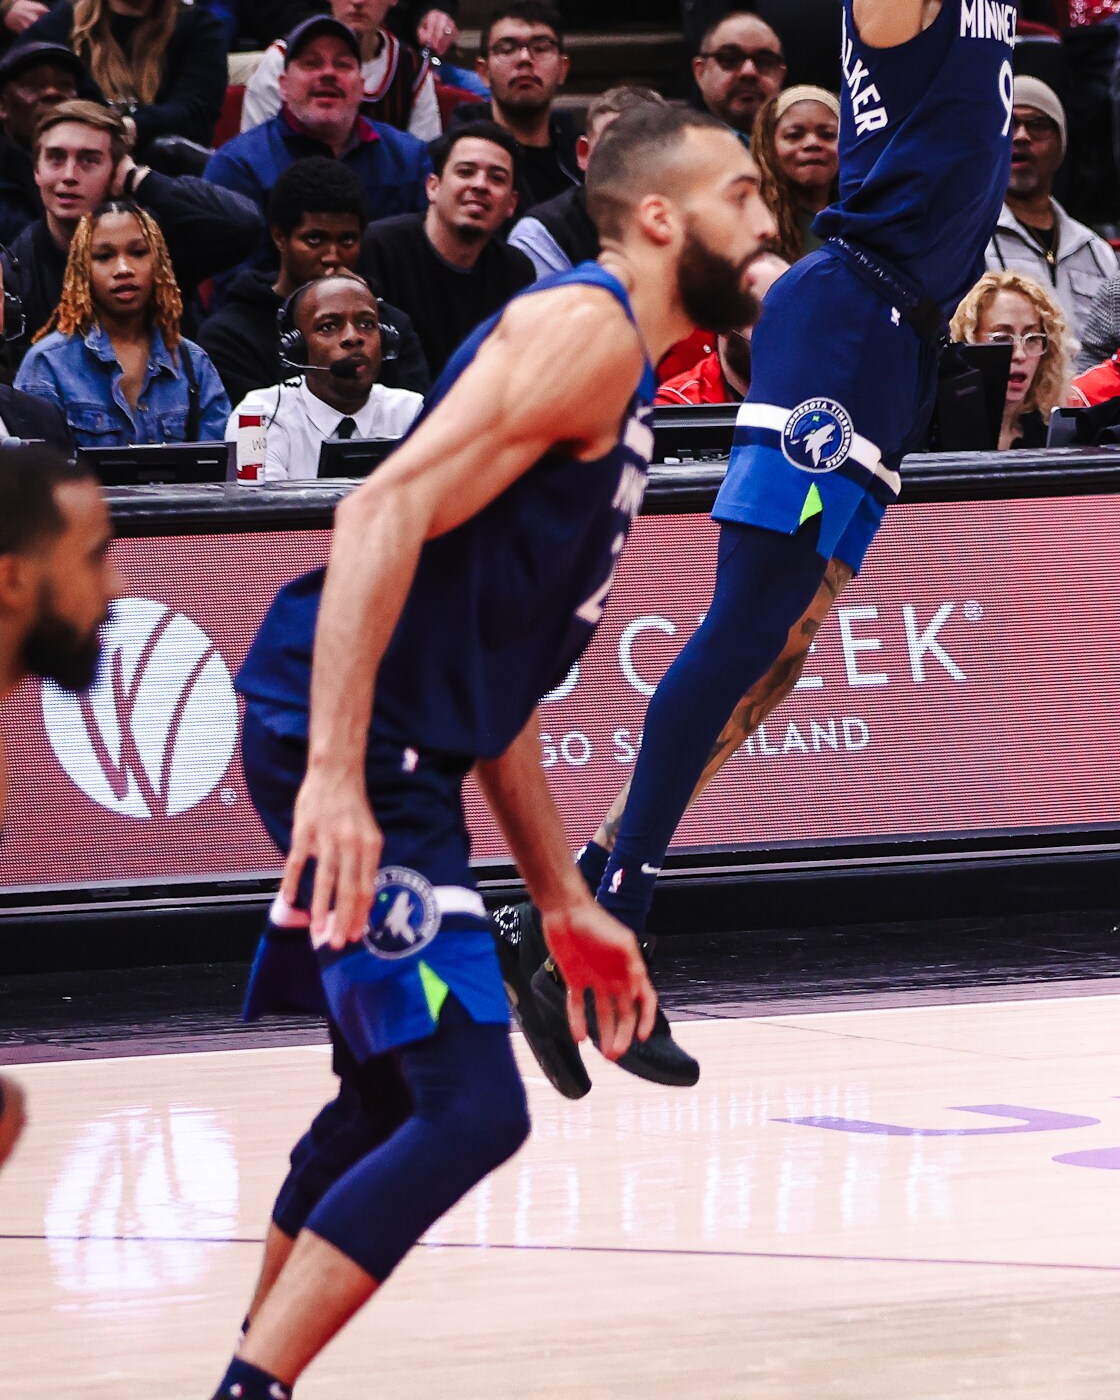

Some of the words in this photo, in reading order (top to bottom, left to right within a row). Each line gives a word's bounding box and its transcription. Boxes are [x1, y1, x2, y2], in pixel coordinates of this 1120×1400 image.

[841, 4, 889, 137] LKER
[785, 401, 827, 435] MINNESOTA
[617, 601, 968, 698] CEK
